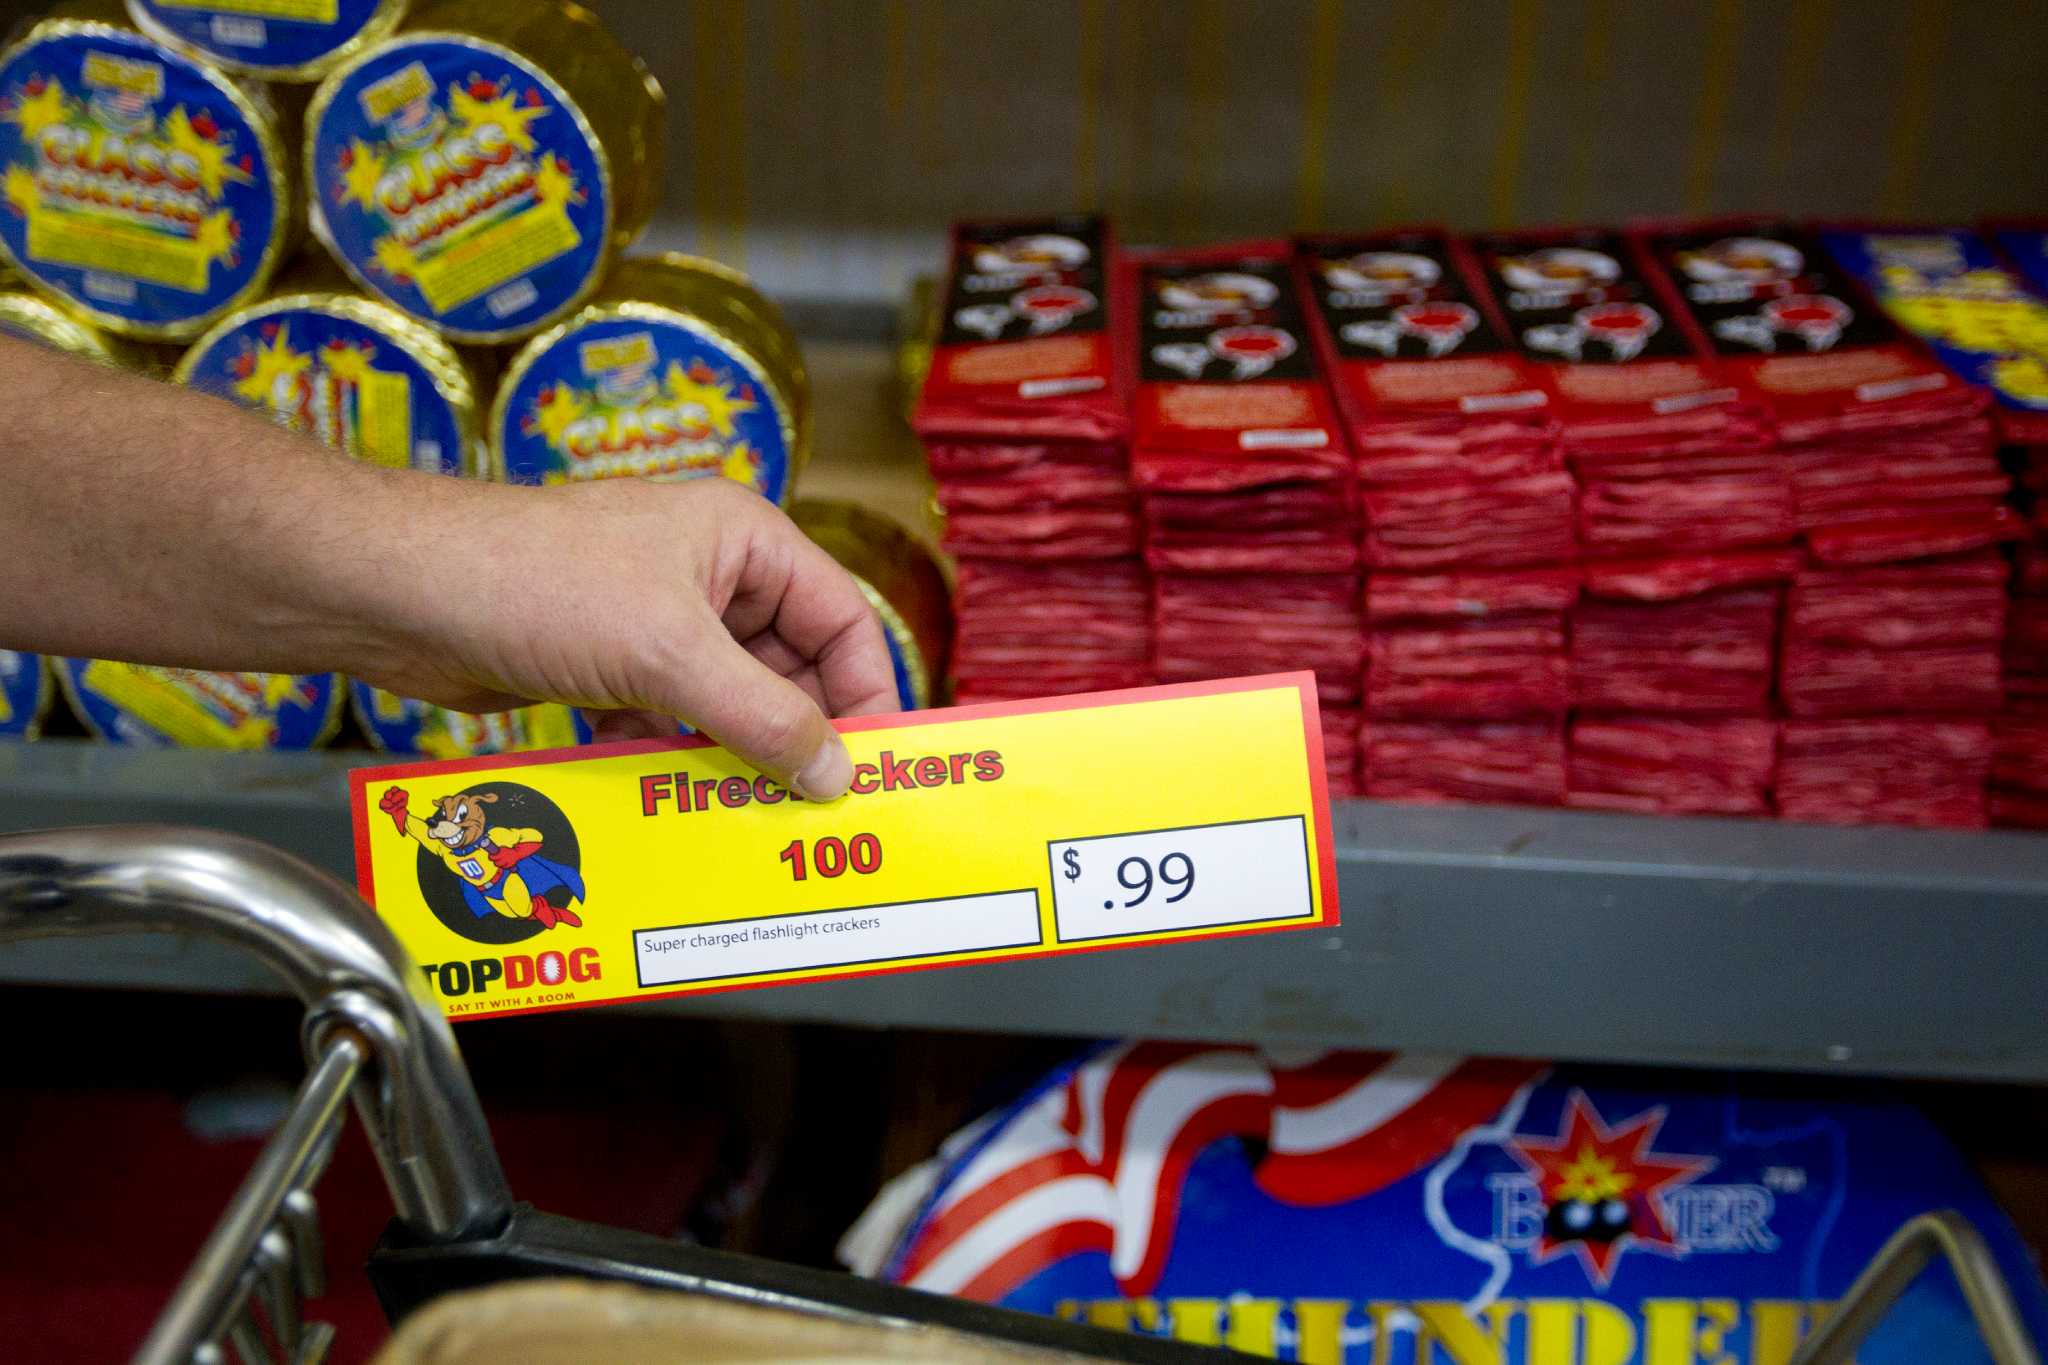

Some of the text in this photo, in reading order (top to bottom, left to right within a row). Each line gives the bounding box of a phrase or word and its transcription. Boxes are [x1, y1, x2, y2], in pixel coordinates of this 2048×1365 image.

[639, 749, 1005, 817] Firecckers
[780, 832, 883, 882] 100
[1062, 846, 1196, 910] $ .99
[643, 916, 881, 954] Super charged flashlight crackers
[448, 992, 576, 1014] SAY IT WITH A BOOM
